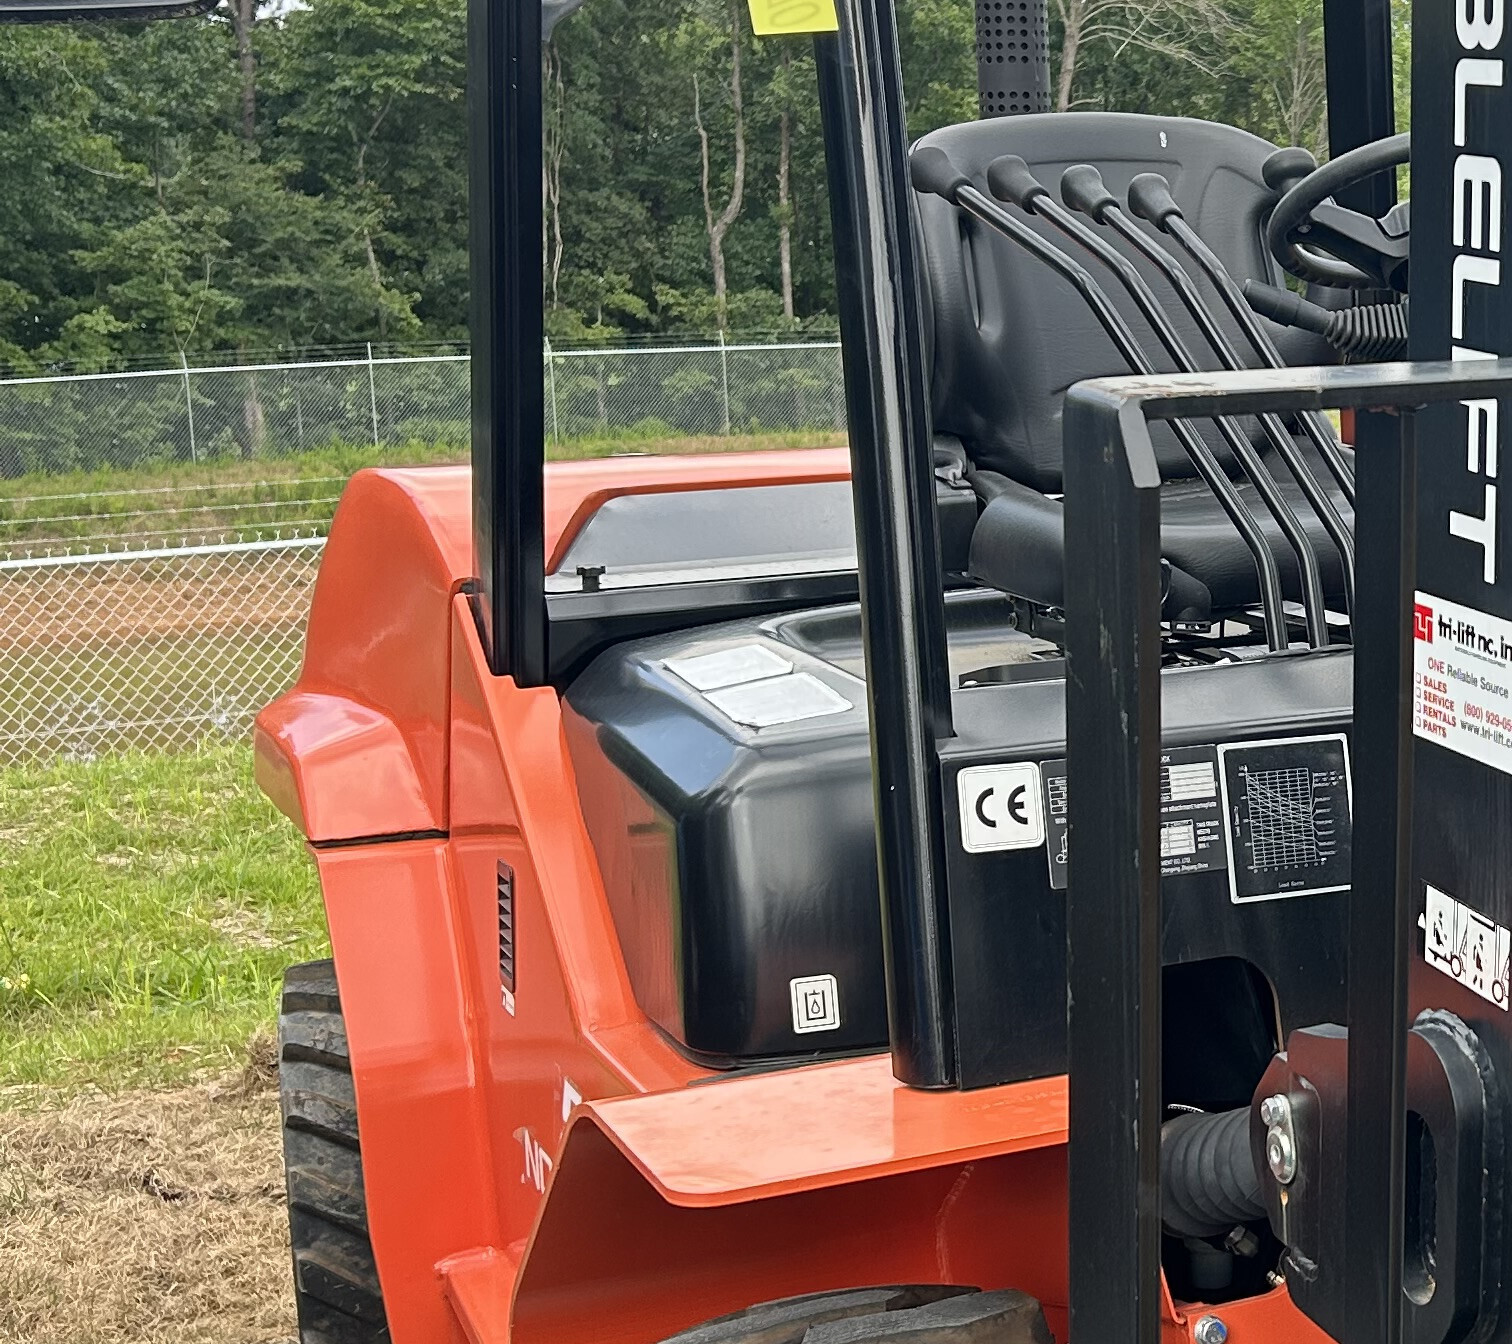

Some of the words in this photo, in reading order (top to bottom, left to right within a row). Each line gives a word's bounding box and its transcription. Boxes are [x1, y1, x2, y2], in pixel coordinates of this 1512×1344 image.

[1438, 614, 1476, 648] tri-lift
[1478, 636, 1497, 658] nc,
[1423, 675, 1447, 694] SALES
[1428, 657, 1445, 675] ONE
[1447, 664, 1478, 687] Reliable
[1480, 677, 1509, 699] Source
[1423, 690, 1455, 712] SERVICE
[1423, 704, 1457, 727] RENTALS
[1423, 721, 1447, 739] PARTS
[975, 784, 1030, 829] CE
